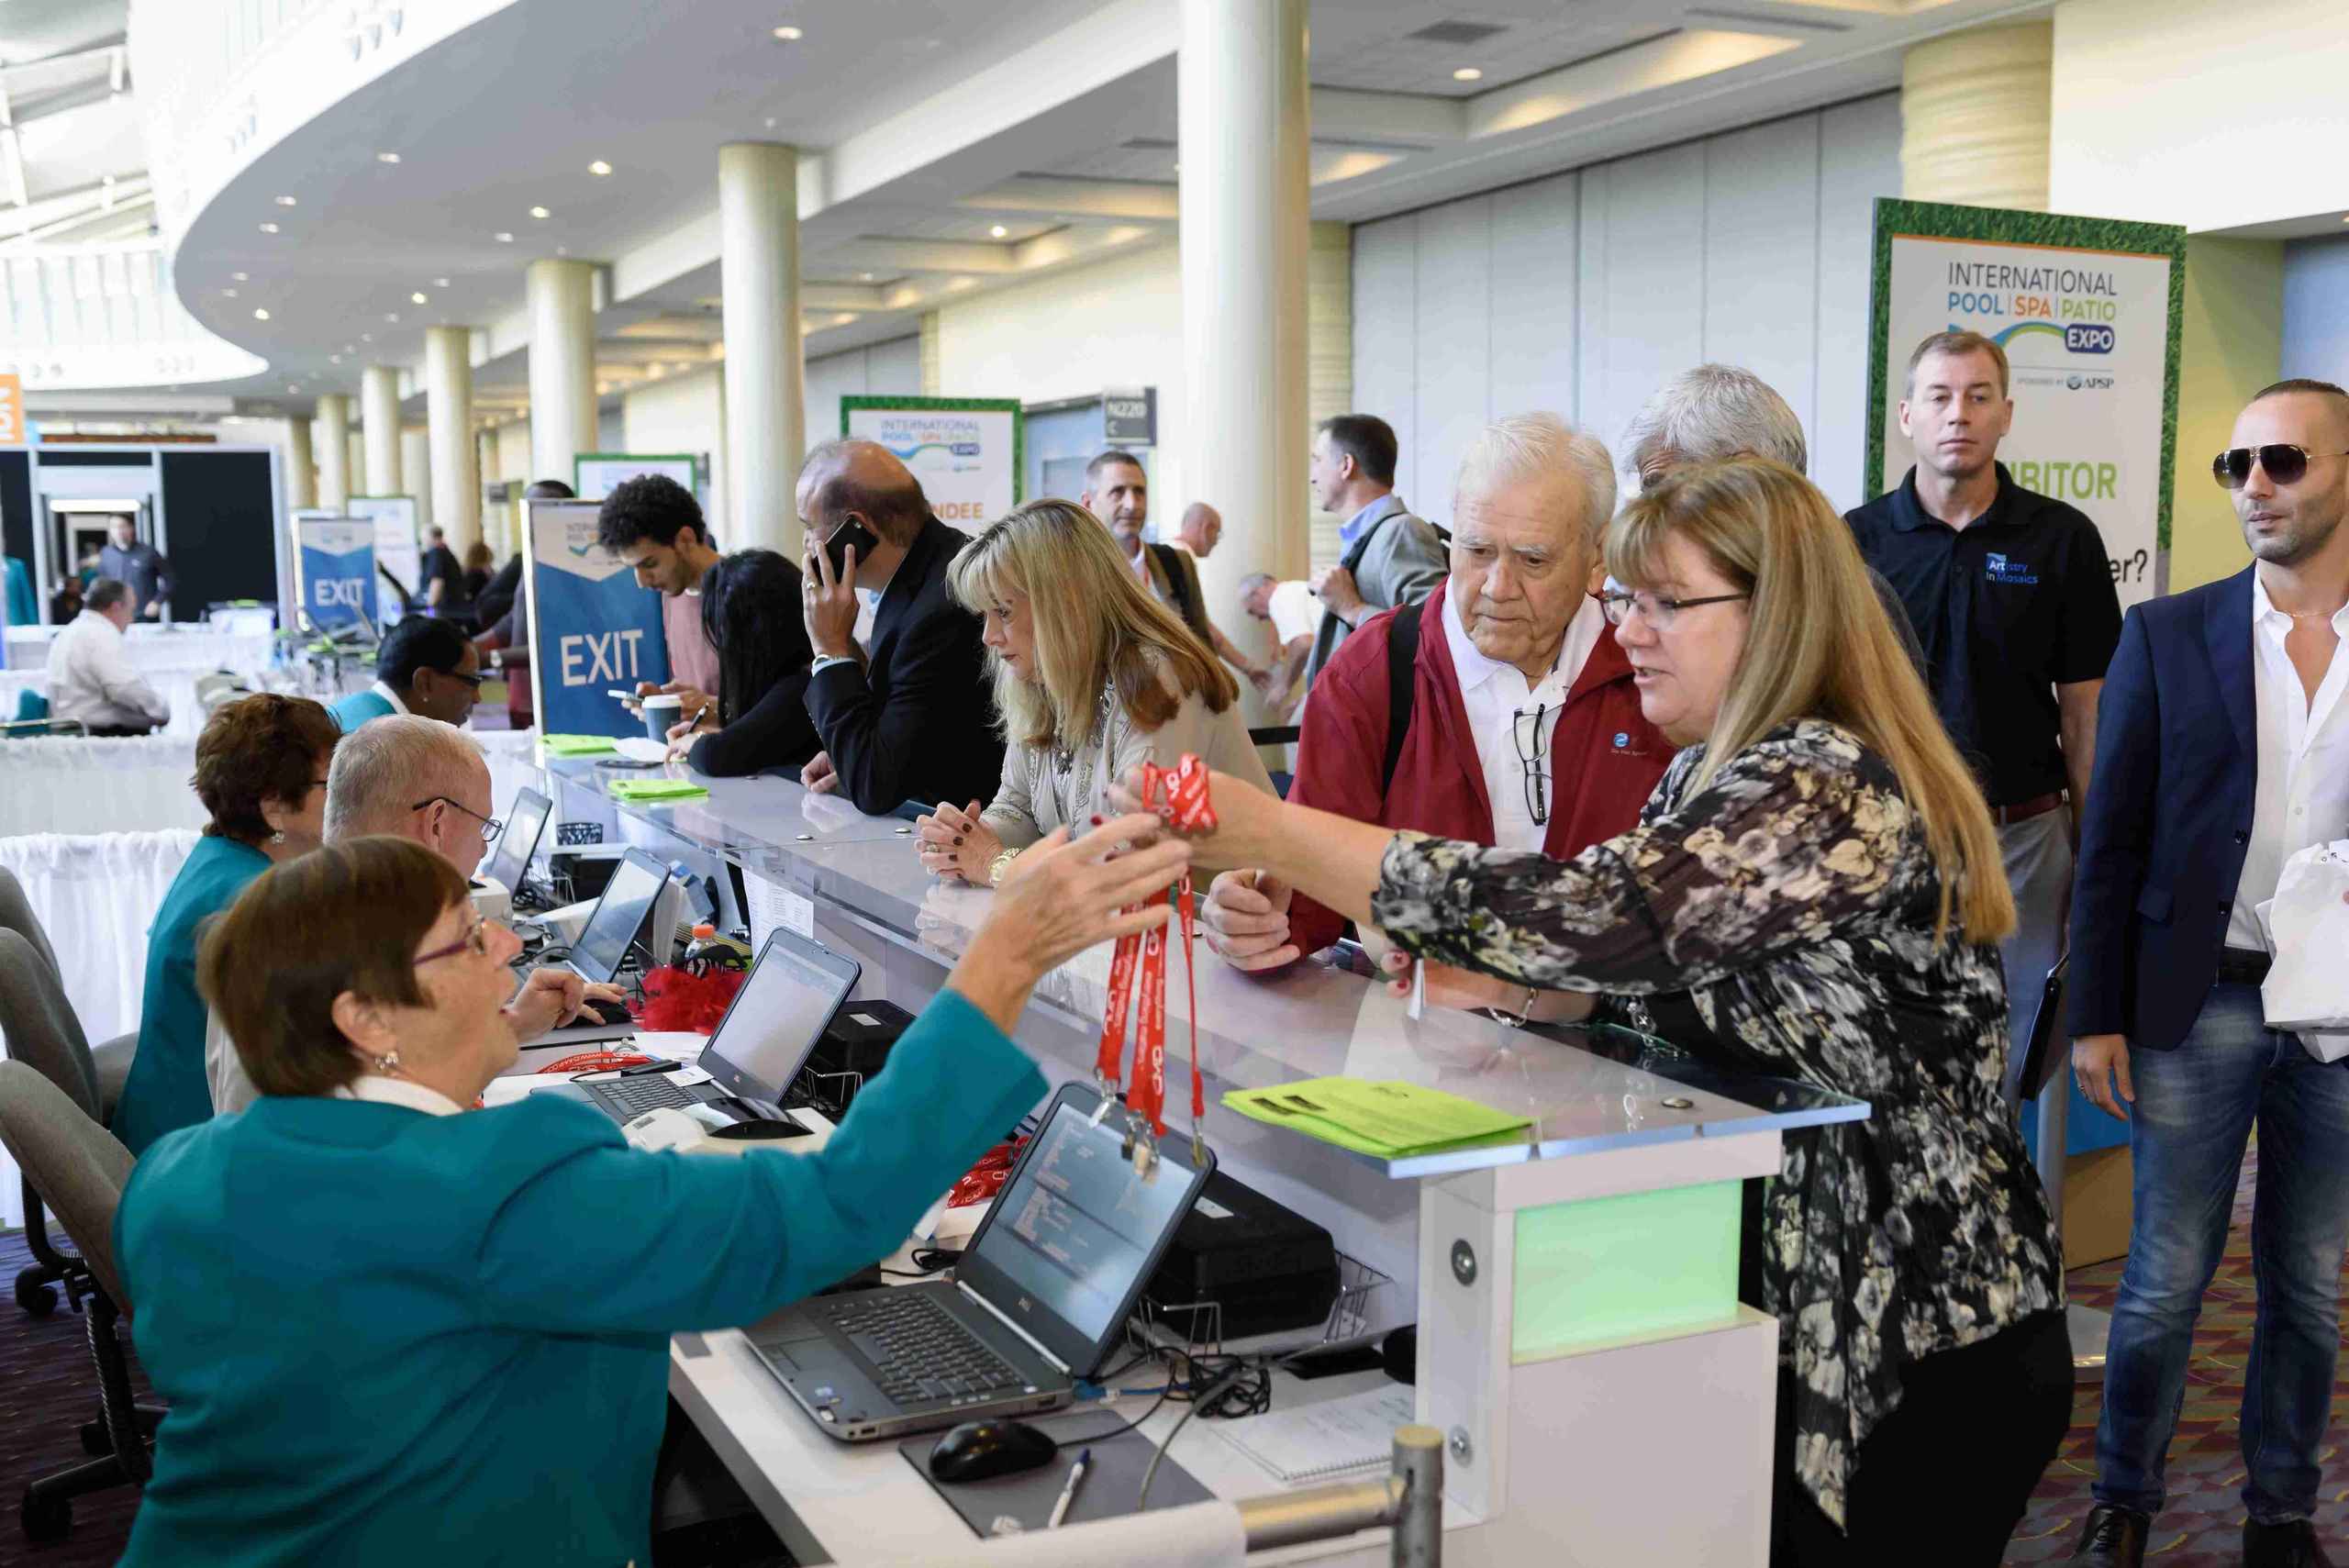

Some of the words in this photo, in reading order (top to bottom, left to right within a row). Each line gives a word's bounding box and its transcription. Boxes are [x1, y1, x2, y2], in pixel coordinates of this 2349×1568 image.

[1948, 261, 2117, 296] INTERNATIONAL
[1948, 292, 2004, 316] POOL
[2014, 295, 2053, 318] SPA
[2061, 298, 2117, 322] PATIO
[2067, 328, 2114, 350] EXPO
[2007, 462, 2117, 499] IBITOR
[315, 578, 366, 607] EXIT
[561, 628, 643, 687] EXIT
